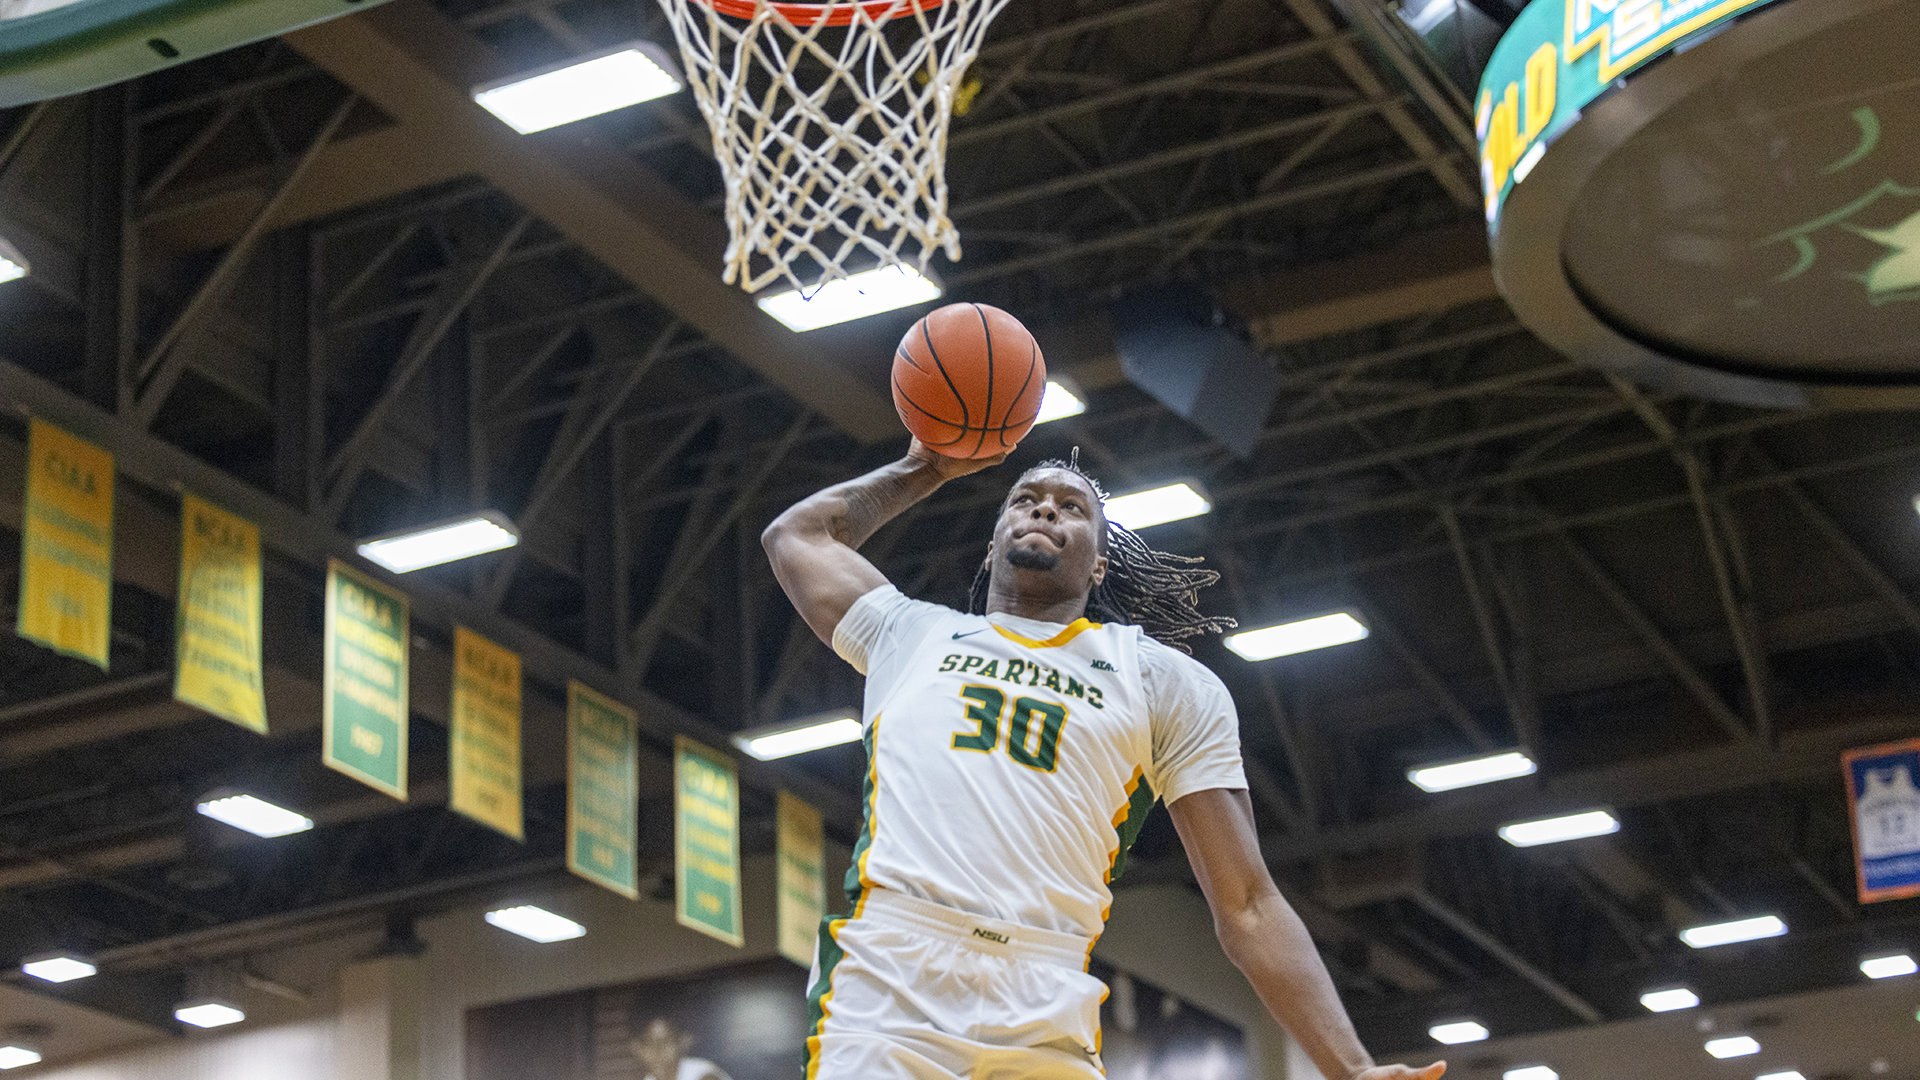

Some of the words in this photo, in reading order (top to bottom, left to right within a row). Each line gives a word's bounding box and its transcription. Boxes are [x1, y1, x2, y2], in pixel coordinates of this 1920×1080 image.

[938, 653, 1104, 710] SPARTANS
[950, 683, 1070, 774] 30
[972, 928, 1010, 945] NSU
